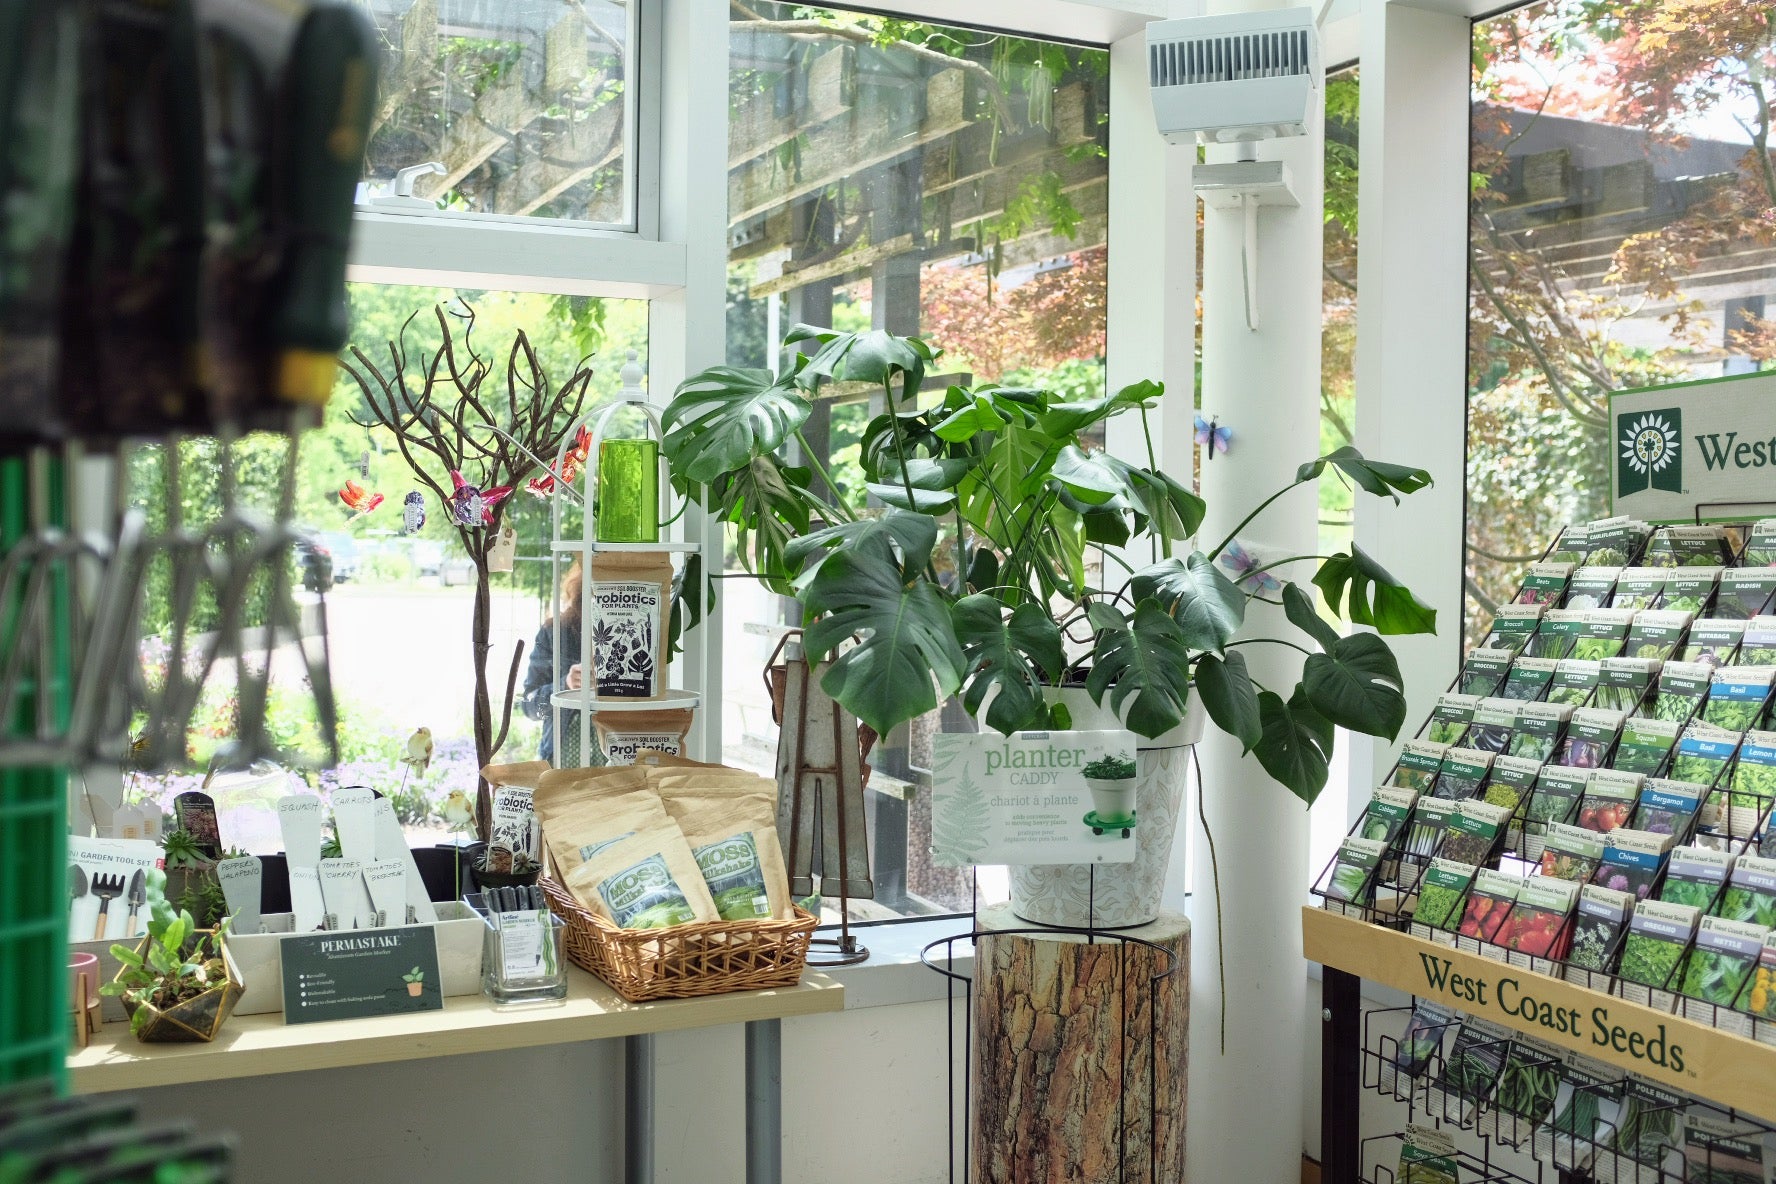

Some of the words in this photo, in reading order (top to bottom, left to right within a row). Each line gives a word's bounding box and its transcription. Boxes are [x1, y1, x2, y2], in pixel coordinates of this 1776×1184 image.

[1695, 432, 1776, 471] West
[1590, 530, 1624, 540] CAULIFLOWER
[594, 592, 657, 606] robiotics
[1503, 620, 1524, 628] Broccoli
[1641, 627, 1667, 635] LETTUCE
[1564, 673, 1588, 681] LETTUCE
[1670, 680, 1695, 689] SPINACH
[1730, 686, 1746, 694] Basil
[1441, 707, 1464, 715] BROCCOLI
[1524, 719, 1547, 727] LETTUCE
[1579, 726, 1601, 735] ONIONS
[1635, 734, 1657, 743] Squash
[1699, 743, 1716, 752] Basil
[1749, 748, 1773, 758] Lemon
[984, 743, 1086, 776] planter
[1452, 765, 1473, 774] Kohlrabi
[1501, 770, 1524, 779] LETTUCE
[1010, 771, 1059, 785] CADDY
[1557, 782, 1572, 790] CHOI
[334, 796, 373, 806] CARROTS
[990, 795, 1030, 807] chariot
[1043, 795, 1079, 808] plante
[1652, 794, 1684, 806] Bergamot
[280, 803, 320, 813] SQUASH
[1462, 817, 1482, 829] Lettuce
[80, 853, 114, 863] GARDEN
[115, 856, 135, 866] TOOL
[137, 859, 152, 867] SET
[697, 843, 752, 870] MOSS
[1618, 852, 1640, 863] Chives
[221, 861, 254, 872] PEPPERS
[322, 861, 361, 870] TOMATOES
[364, 862, 403, 873] TOMATOES
[1438, 871, 1458, 882] Lettuce
[1748, 875, 1775, 886] NETTLE
[1586, 903, 1612, 917] CARAWAY
[1643, 921, 1676, 934] OREGANO
[320, 935, 402, 953] PERMASTAKE
[1419, 952, 1487, 1005] West
[1497, 978, 1581, 1038] Coast
[1592, 1007, 1685, 1072] Seeds
[1464, 1028, 1480, 1040] BUSH
[1515, 1044, 1533, 1057] BUSH
[1568, 1070, 1589, 1084] BUSH
[1635, 1083, 1655, 1097] POLE
[1655, 1089, 1680, 1105] BEANS
[1719, 1137, 1751, 1153] BEANS
